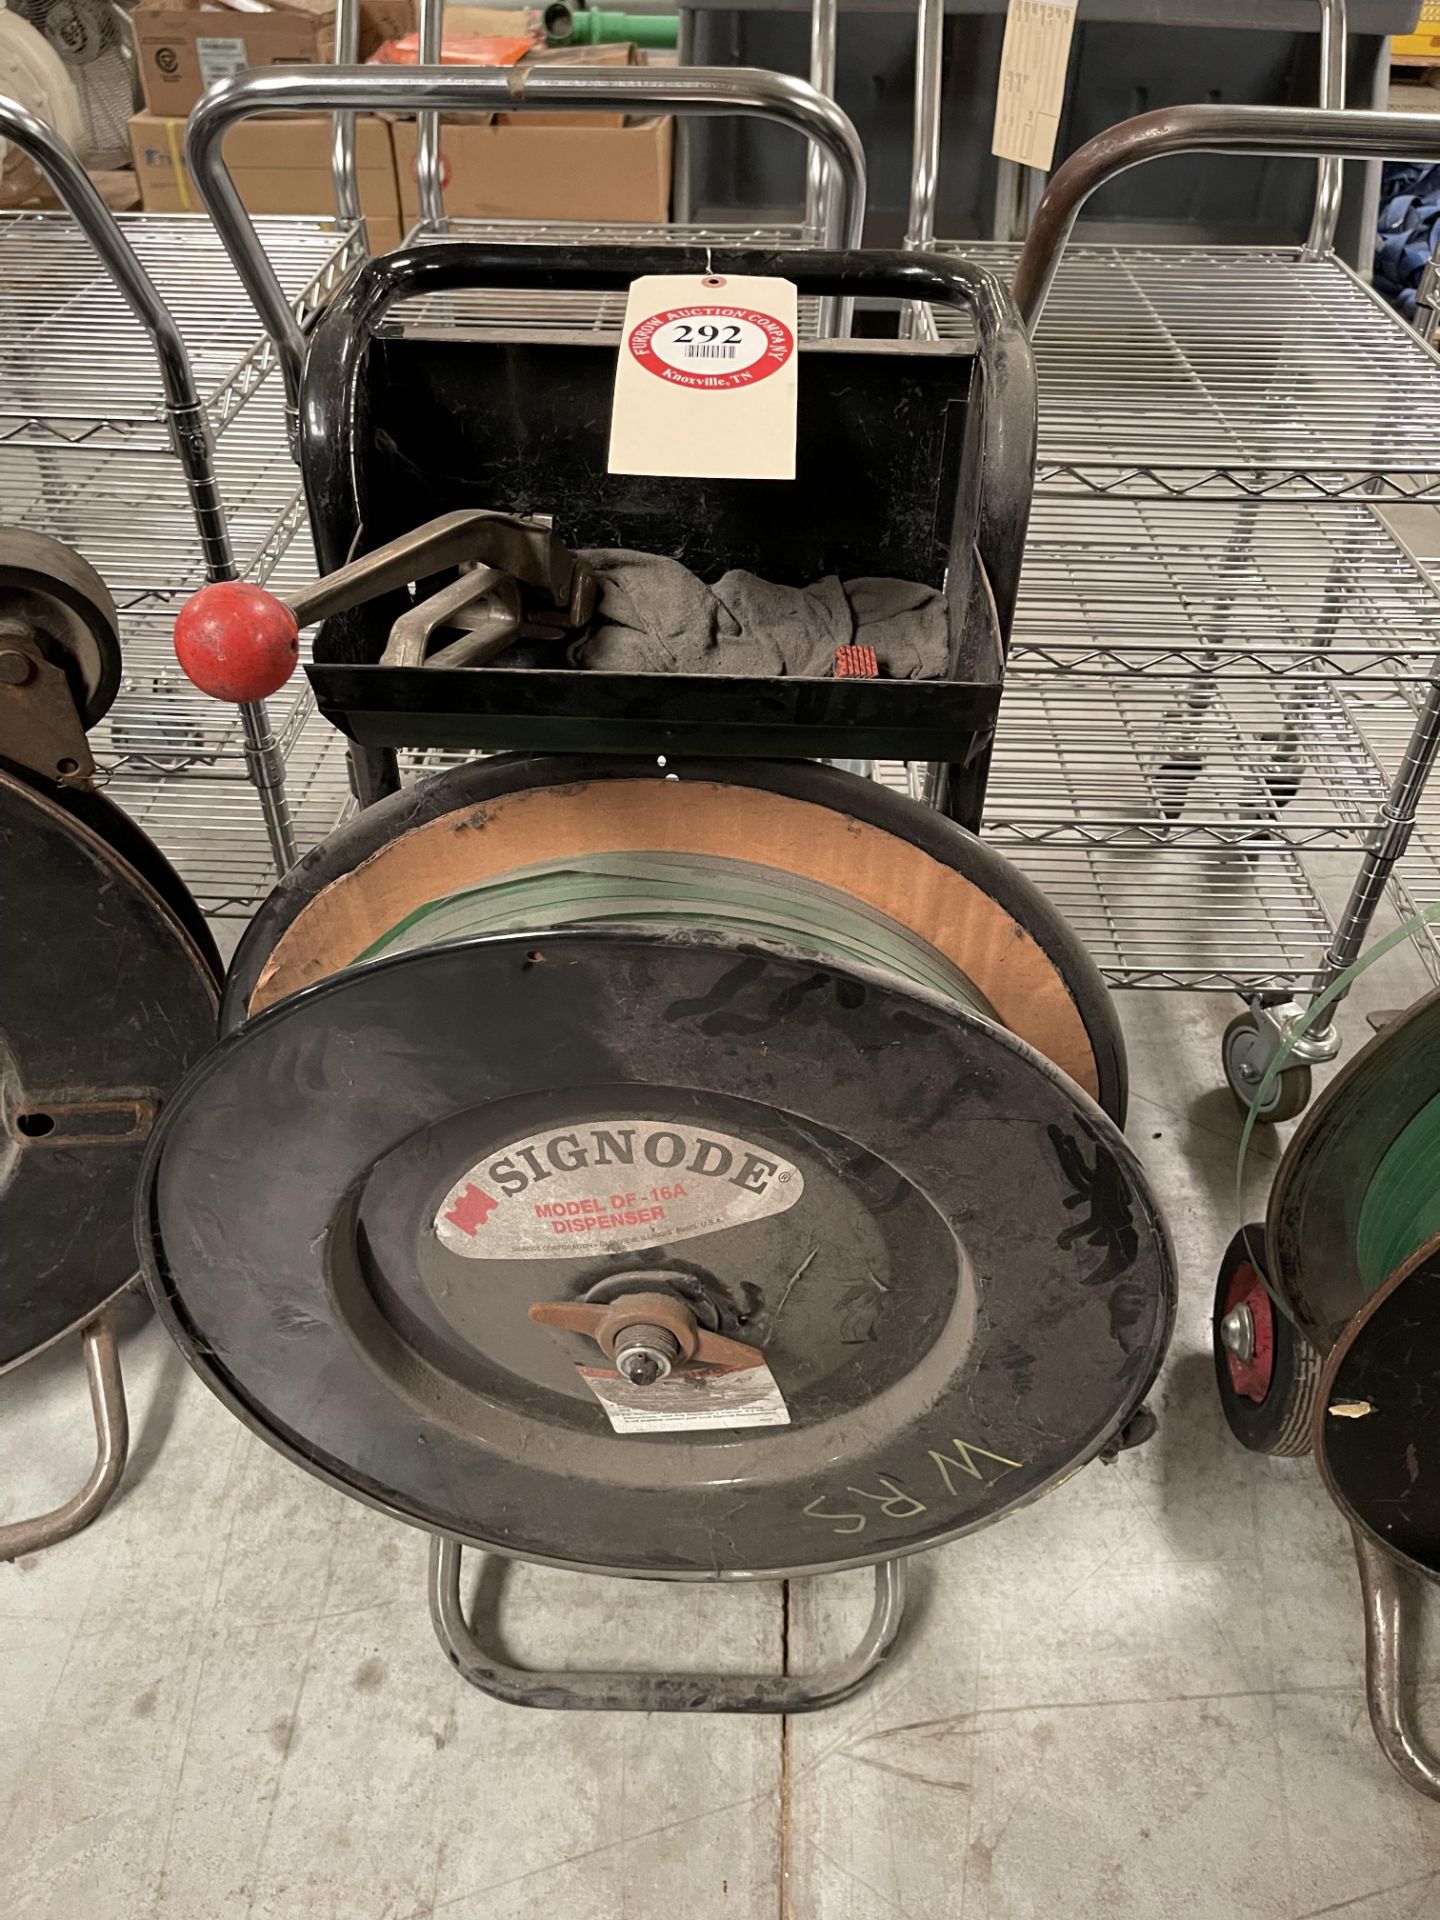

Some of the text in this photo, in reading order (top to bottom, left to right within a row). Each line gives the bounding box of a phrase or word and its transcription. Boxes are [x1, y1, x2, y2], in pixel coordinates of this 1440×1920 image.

[631, 308, 789, 362] FURROW AUCTION COMPANY
[672, 324, 743, 345] 292
[662, 368, 753, 387] Knoxville, TN
[488, 1129, 778, 1198] SIGNODE
[534, 1199, 607, 1218] MODEL
[551, 1205, 666, 1234] DISPENSER
